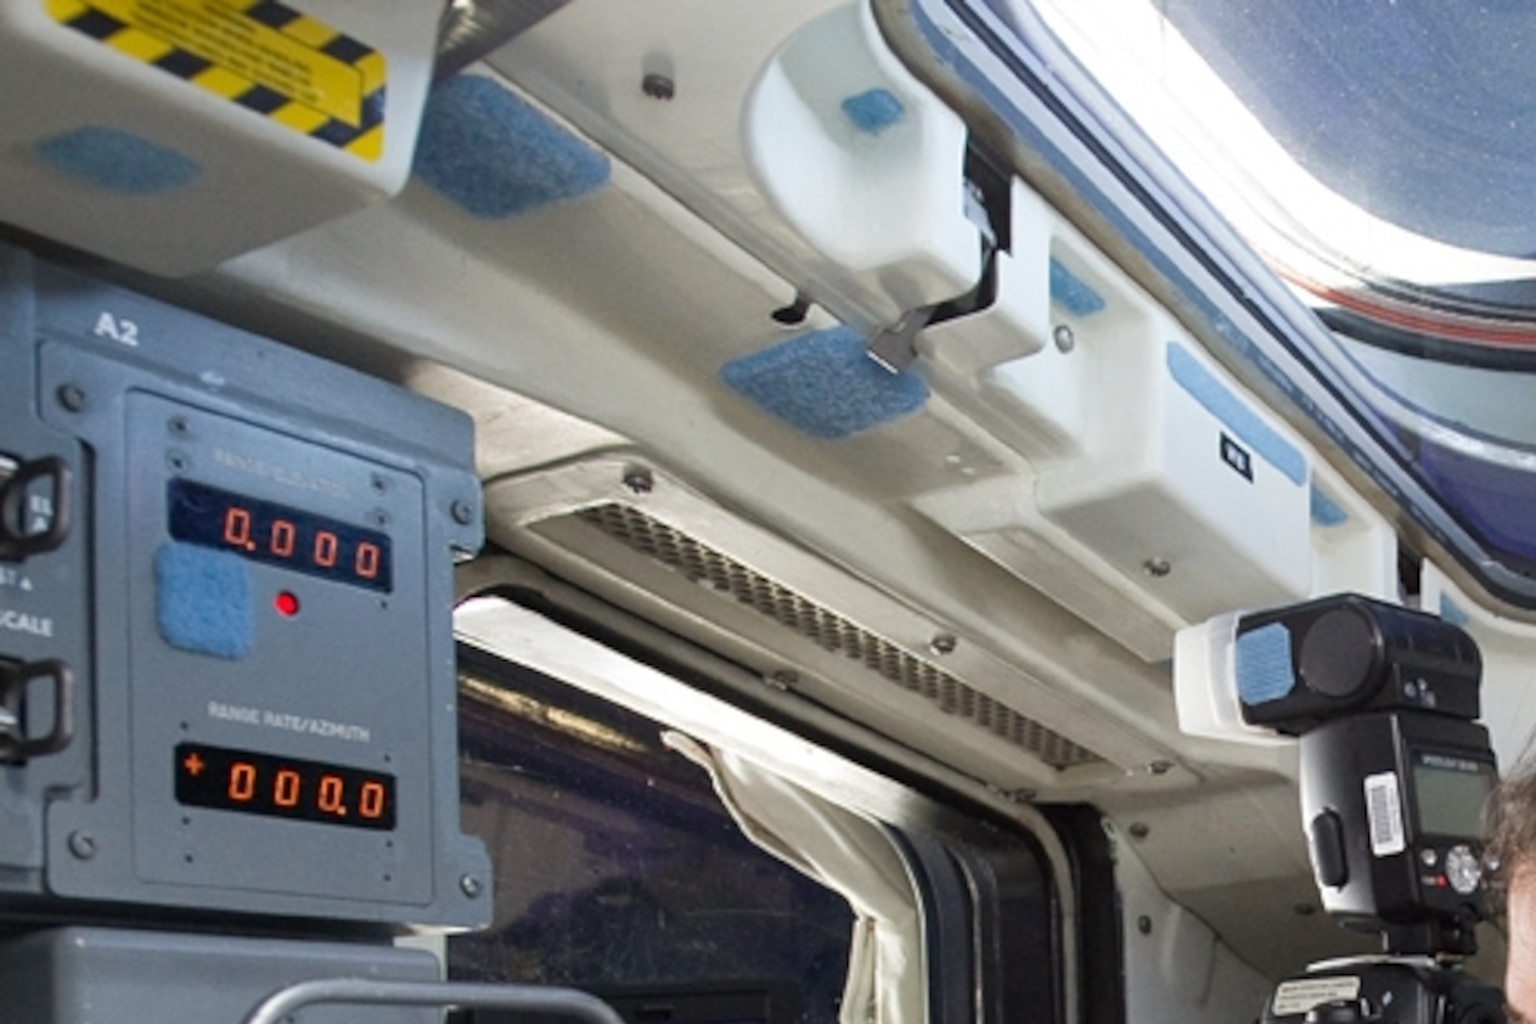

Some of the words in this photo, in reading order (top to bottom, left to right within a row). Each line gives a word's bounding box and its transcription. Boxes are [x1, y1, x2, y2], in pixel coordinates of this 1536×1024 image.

[94, 311, 138, 347] A2
[0, 609, 53, 638] CALE
[207, 701, 261, 725] RANGE
[263, 710, 371, 742] RATE/AZIMUTH
